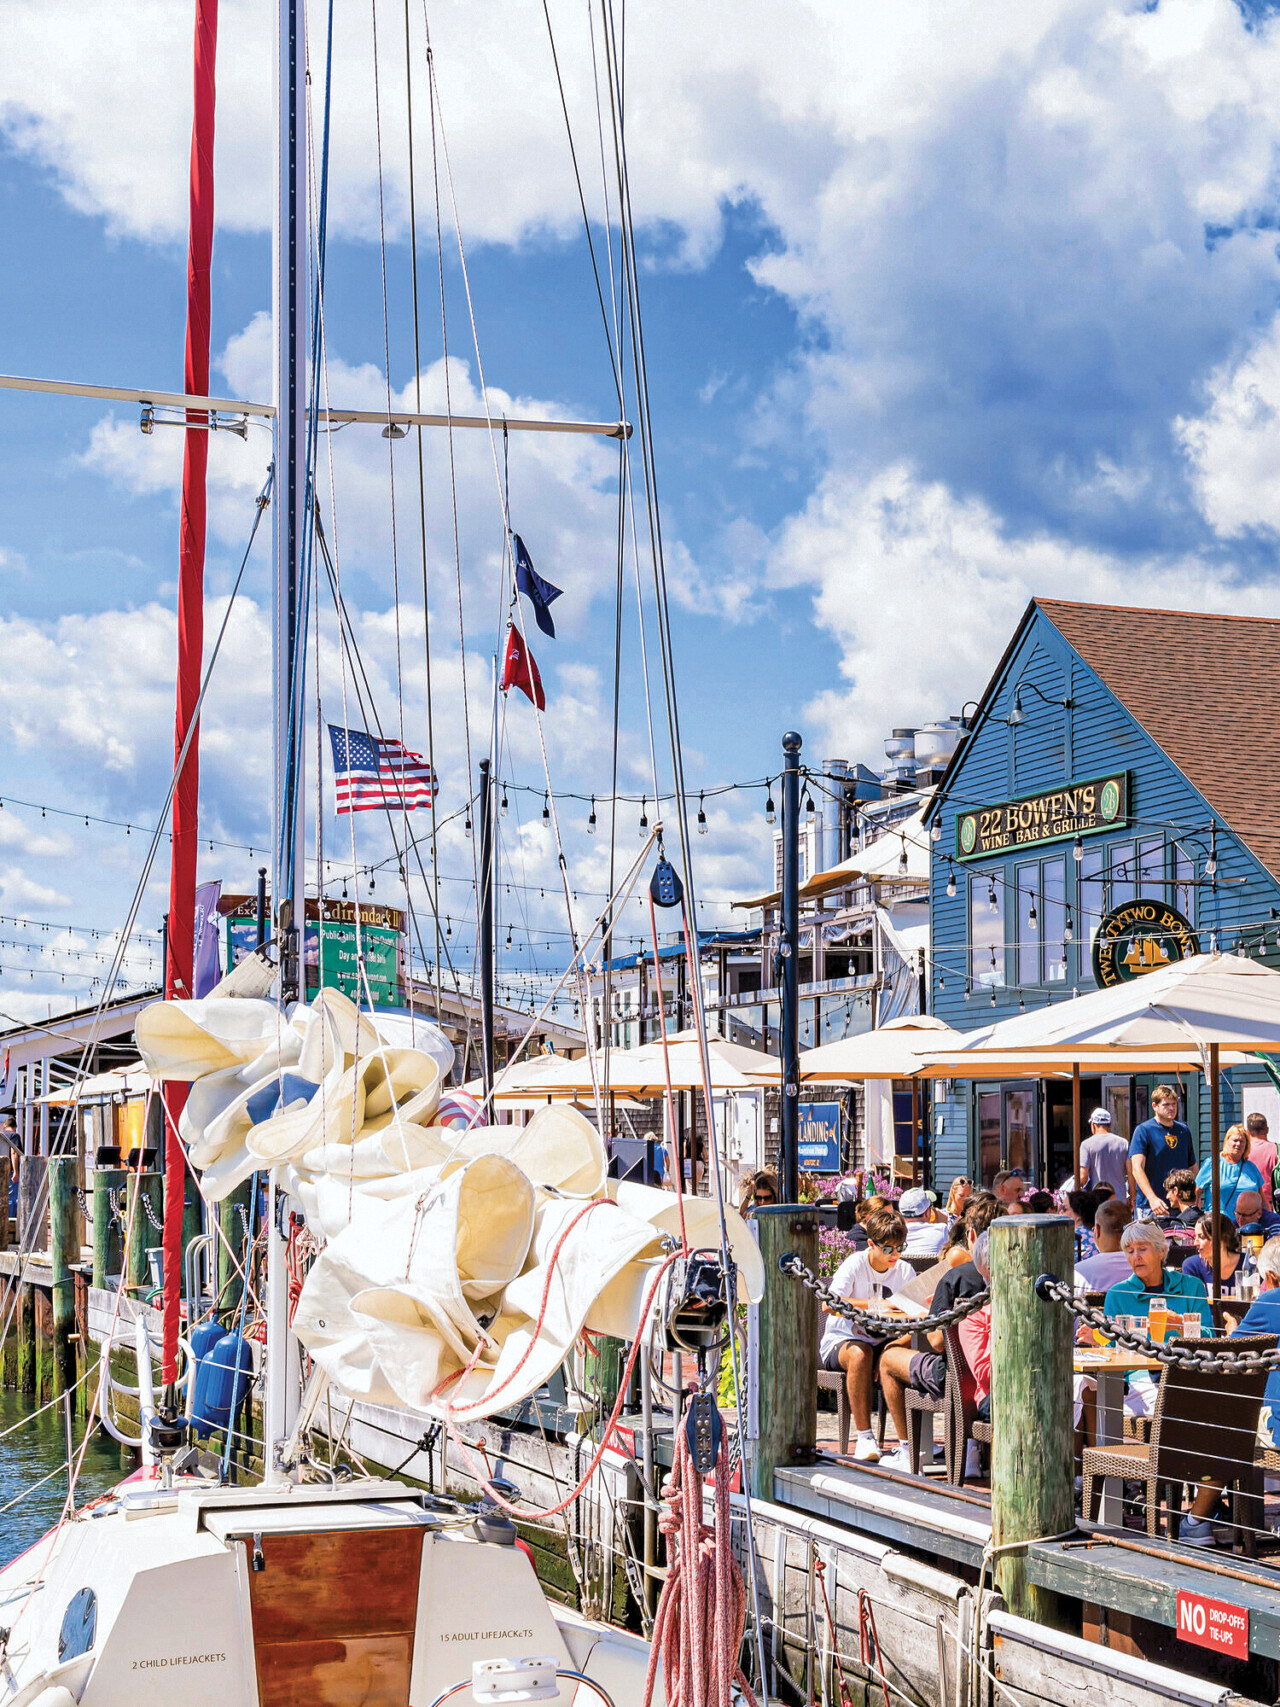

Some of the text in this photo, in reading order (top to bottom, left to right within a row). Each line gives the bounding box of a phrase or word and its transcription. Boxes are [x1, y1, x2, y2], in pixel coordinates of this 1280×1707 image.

[980, 786, 1096, 838] 22 BOWEN'S
[981, 813, 1096, 851] WINE BAR & GRILLE
[322, 903, 391, 926] dirondack
[339, 950, 350, 962] Day
[1181, 1600, 1245, 1635] NO DROP-OFFS
[440, 1634, 450, 1642] 15
[451, 1632, 479, 1641] ADULT
[1209, 1626, 1233, 1645] TIE-UPS
[132, 1653, 226, 1670] 2 CHILD LIFEJACKETS
